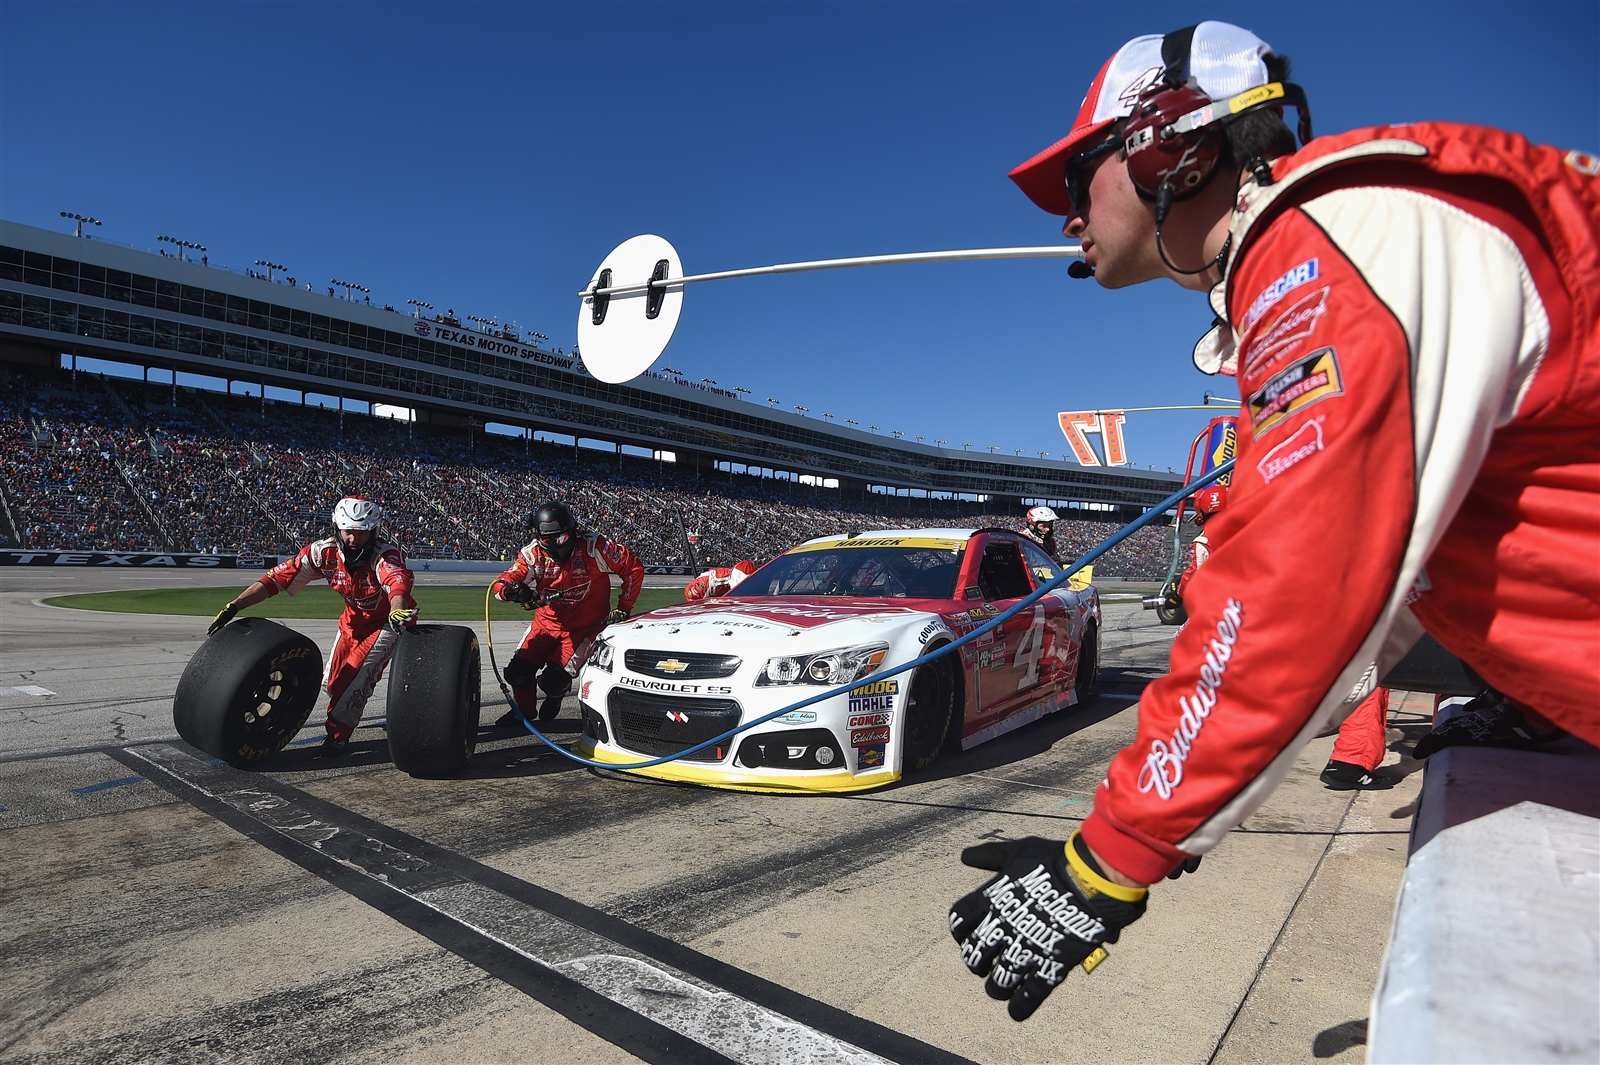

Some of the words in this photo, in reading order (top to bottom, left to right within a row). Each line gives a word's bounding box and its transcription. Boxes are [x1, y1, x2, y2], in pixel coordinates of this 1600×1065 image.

[1248, 261, 1312, 322] NASCAR
[434, 327, 476, 346] TEXAS
[477, 337, 519, 357] MOTOR
[520, 349, 574, 370] SPEEDWAY
[1279, 372, 1328, 407] CENTERS
[1219, 430, 1237, 485] SNOCO
[1265, 440, 1318, 477] Hanes
[833, 539, 904, 548] HARVICK
[10, 553, 222, 566] TEXAS
[269, 648, 311, 671] EAGLE
[1013, 604, 1046, 690] 4
[620, 676, 701, 693] CHEVROLET
[707, 686, 732, 694] SS
[849, 680, 897, 697] MOOG
[1138, 598, 1243, 800] Budweiser
[849, 696, 893, 712] MAHLE
[849, 715, 881, 727] COMP
[852, 730, 888, 744] Edelbrock
[859, 751, 884, 762] SUNOCO
[985, 874, 1066, 953] Mechanix
[1018, 863, 1106, 943] Mechanix
